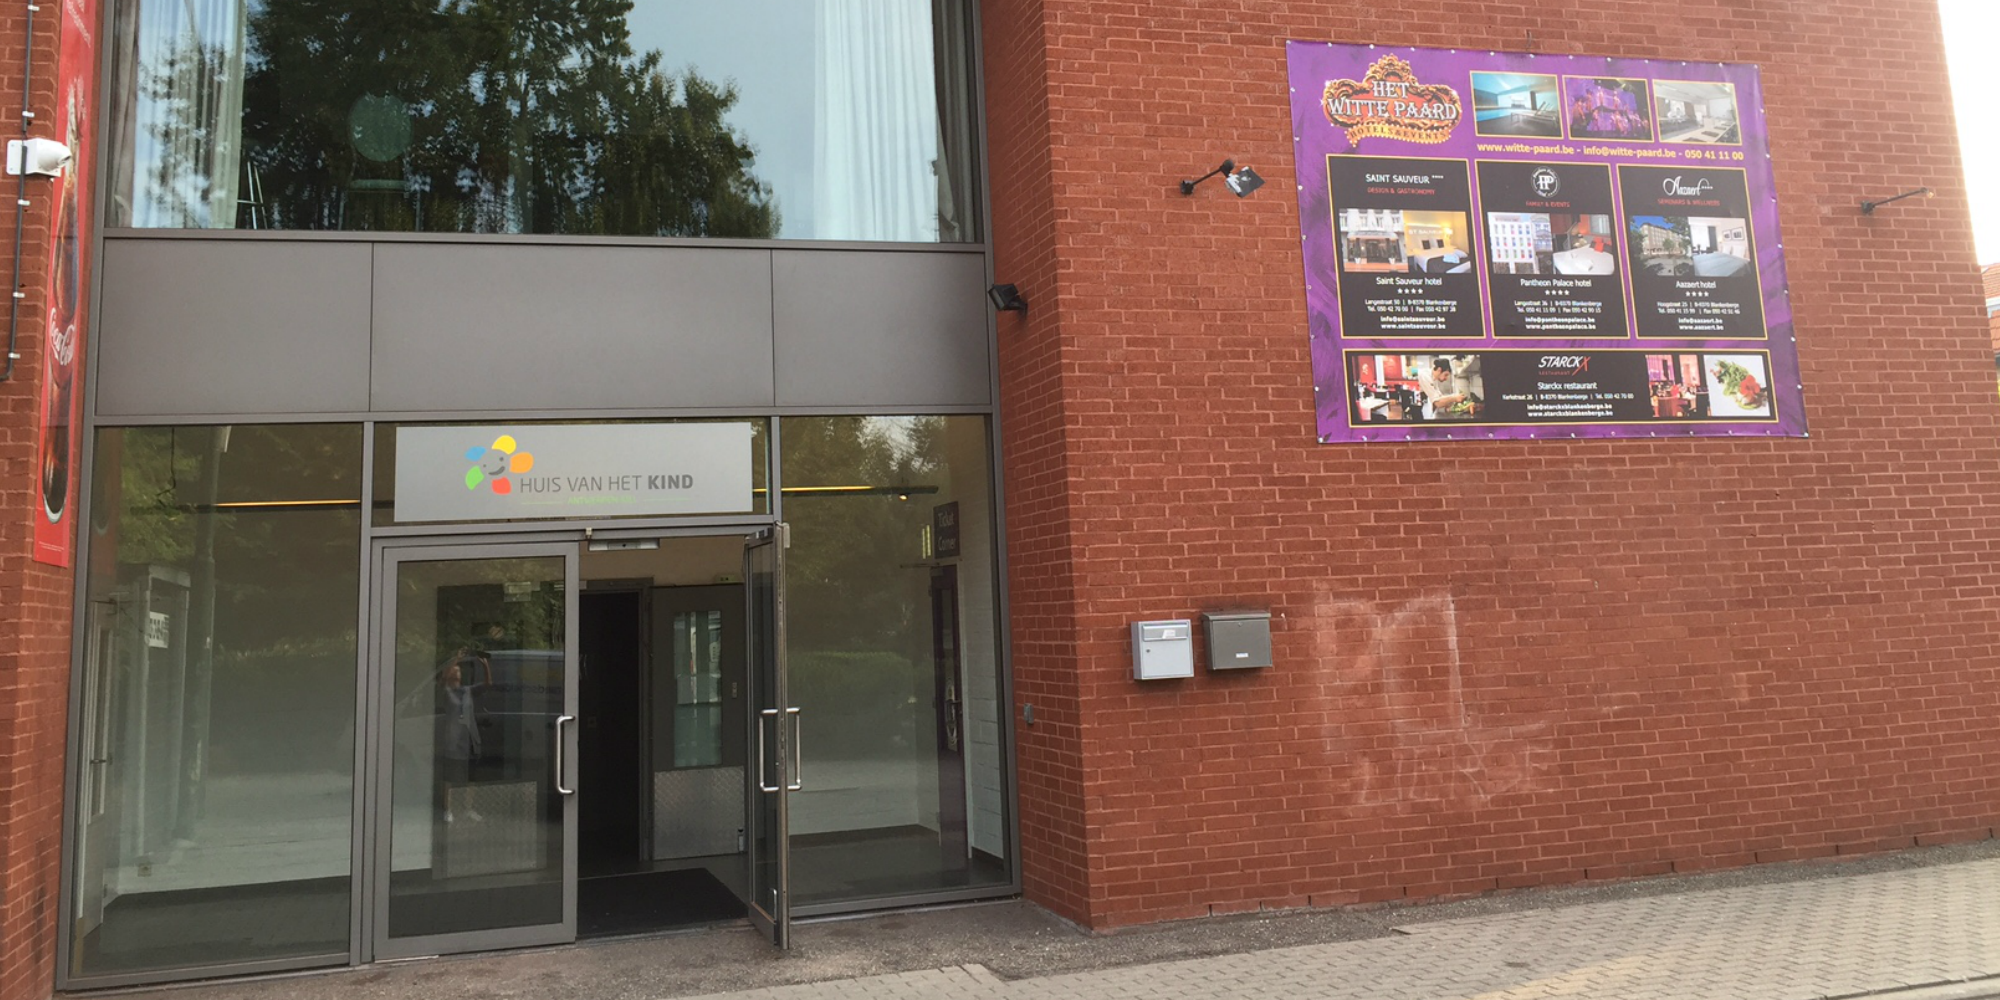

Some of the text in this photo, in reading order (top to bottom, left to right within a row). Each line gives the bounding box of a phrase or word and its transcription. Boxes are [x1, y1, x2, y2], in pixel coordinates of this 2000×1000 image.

[1372, 80, 1410, 99] HET
[1327, 97, 1457, 121] WITTE PAARD
[1477, 142, 1574, 156] www.witte-paard.be
[1583, 145, 1676, 159] info@witte-paard.be
[1684, 150, 1702, 159] 050
[1703, 151, 1716, 160] 41
[1718, 151, 1730, 160] 11
[1731, 151, 1744, 161] 00
[1365, 173, 1431, 185] SAINT SAUVEUR
[1397, 187, 1436, 195] GASTRONOMY
[1376, 277, 1443, 286] Saint Sauveur hotel
[1520, 279, 1592, 288] Pantheon Palace hotel
[1676, 281, 1717, 289] Aazaert hotel
[1525, 316, 1595, 324] info@pantheonpalace.be
[1678, 317, 1723, 325] info@aazaert.be
[1538, 355, 1591, 376] STARCKX
[1537, 381, 1597, 391] Starckx restaurant
[1527, 403, 1613, 411] info@starckxblankenberge.be
[520, 474, 694, 493] HUIS VAN HET KIND
